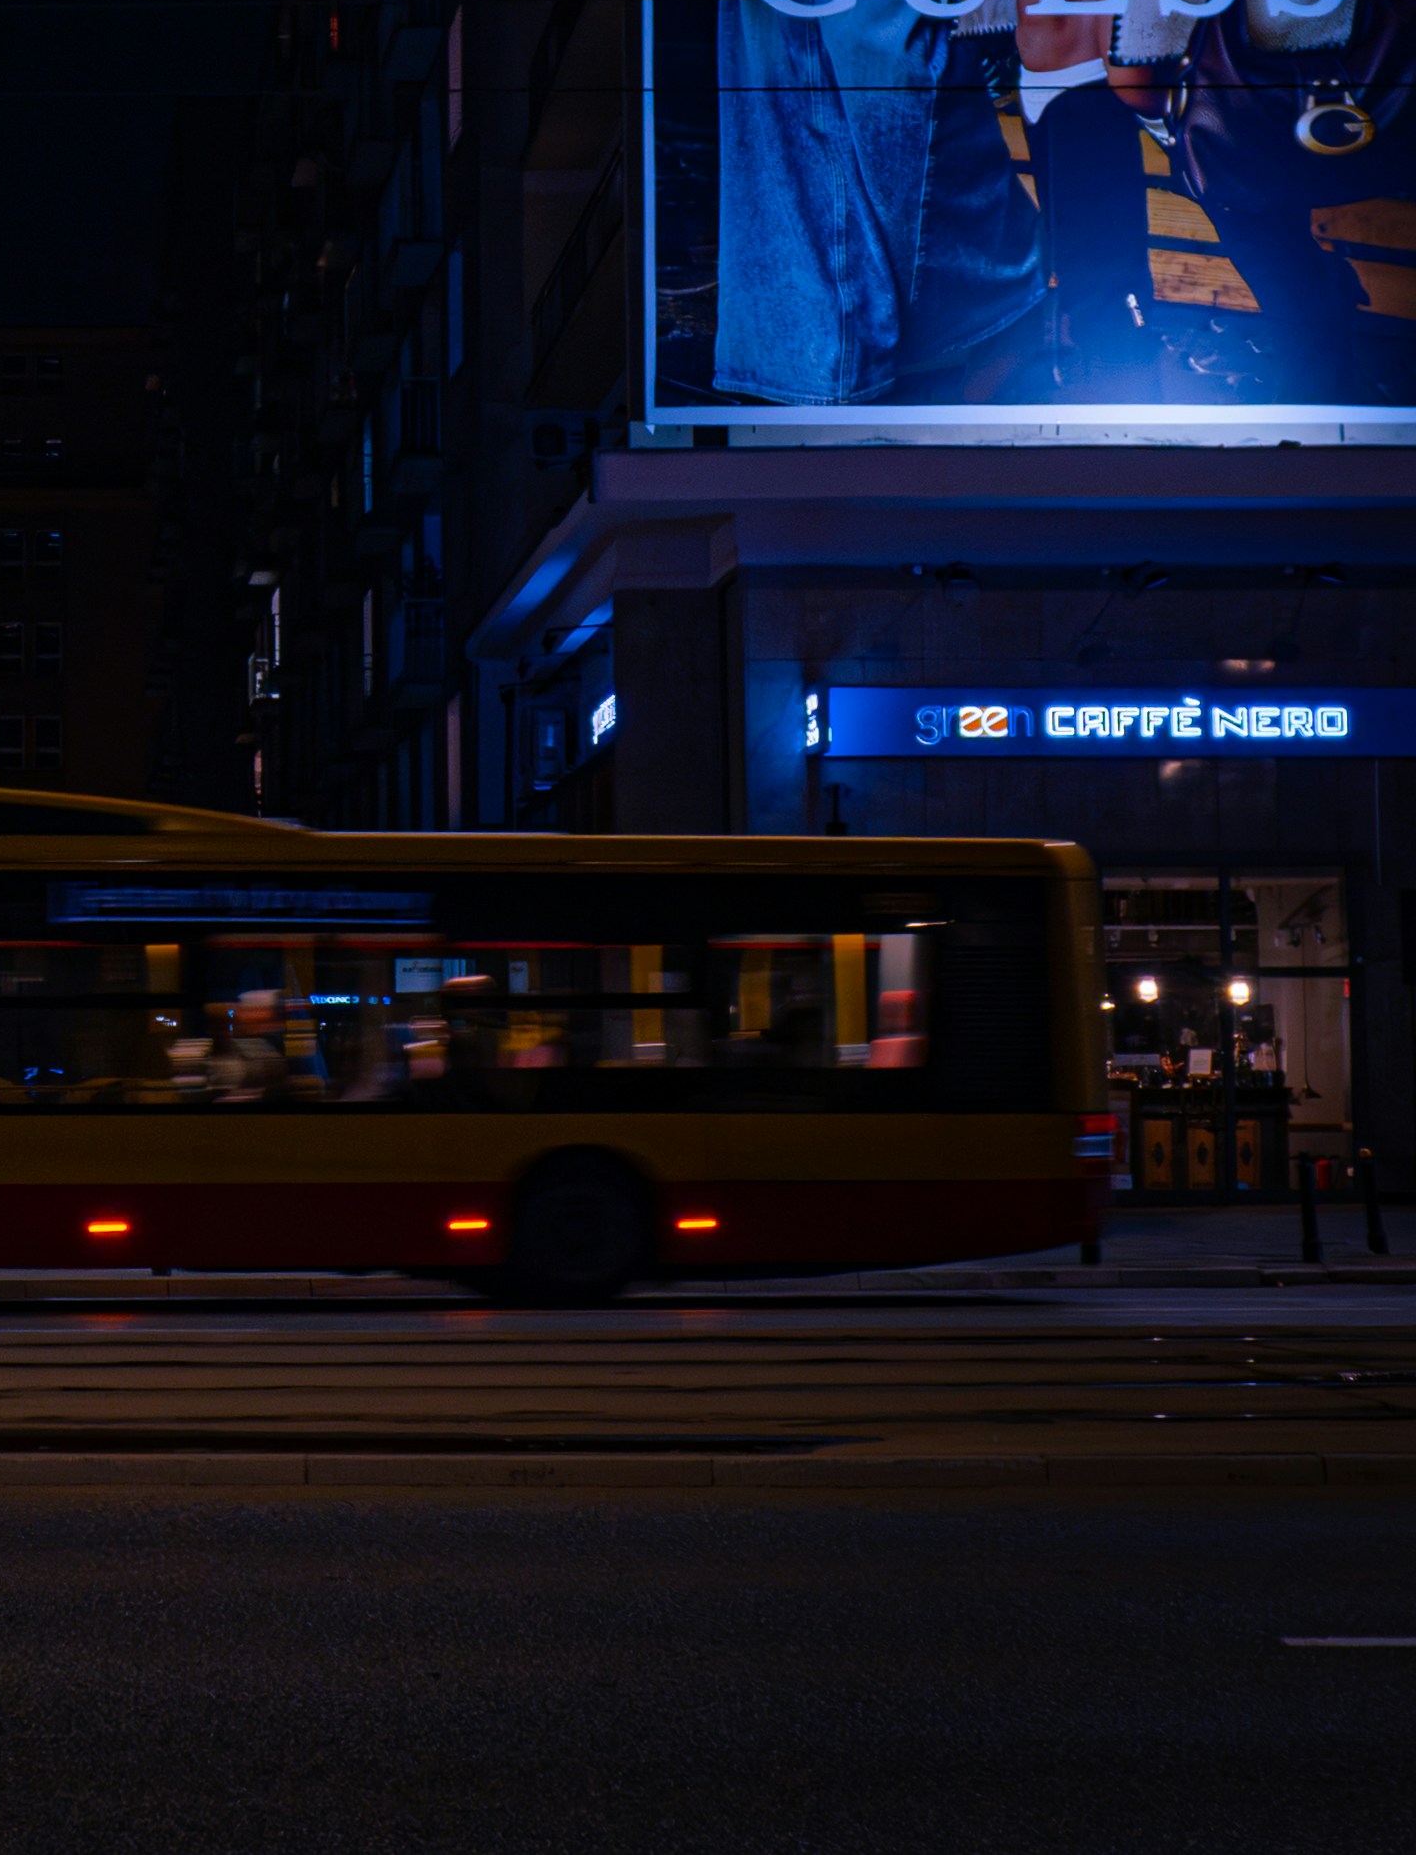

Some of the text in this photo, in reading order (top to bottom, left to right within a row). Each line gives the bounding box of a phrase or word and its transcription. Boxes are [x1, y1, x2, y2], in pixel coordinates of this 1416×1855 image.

[915, 697, 1349, 745] green CAFFÈ NERO
